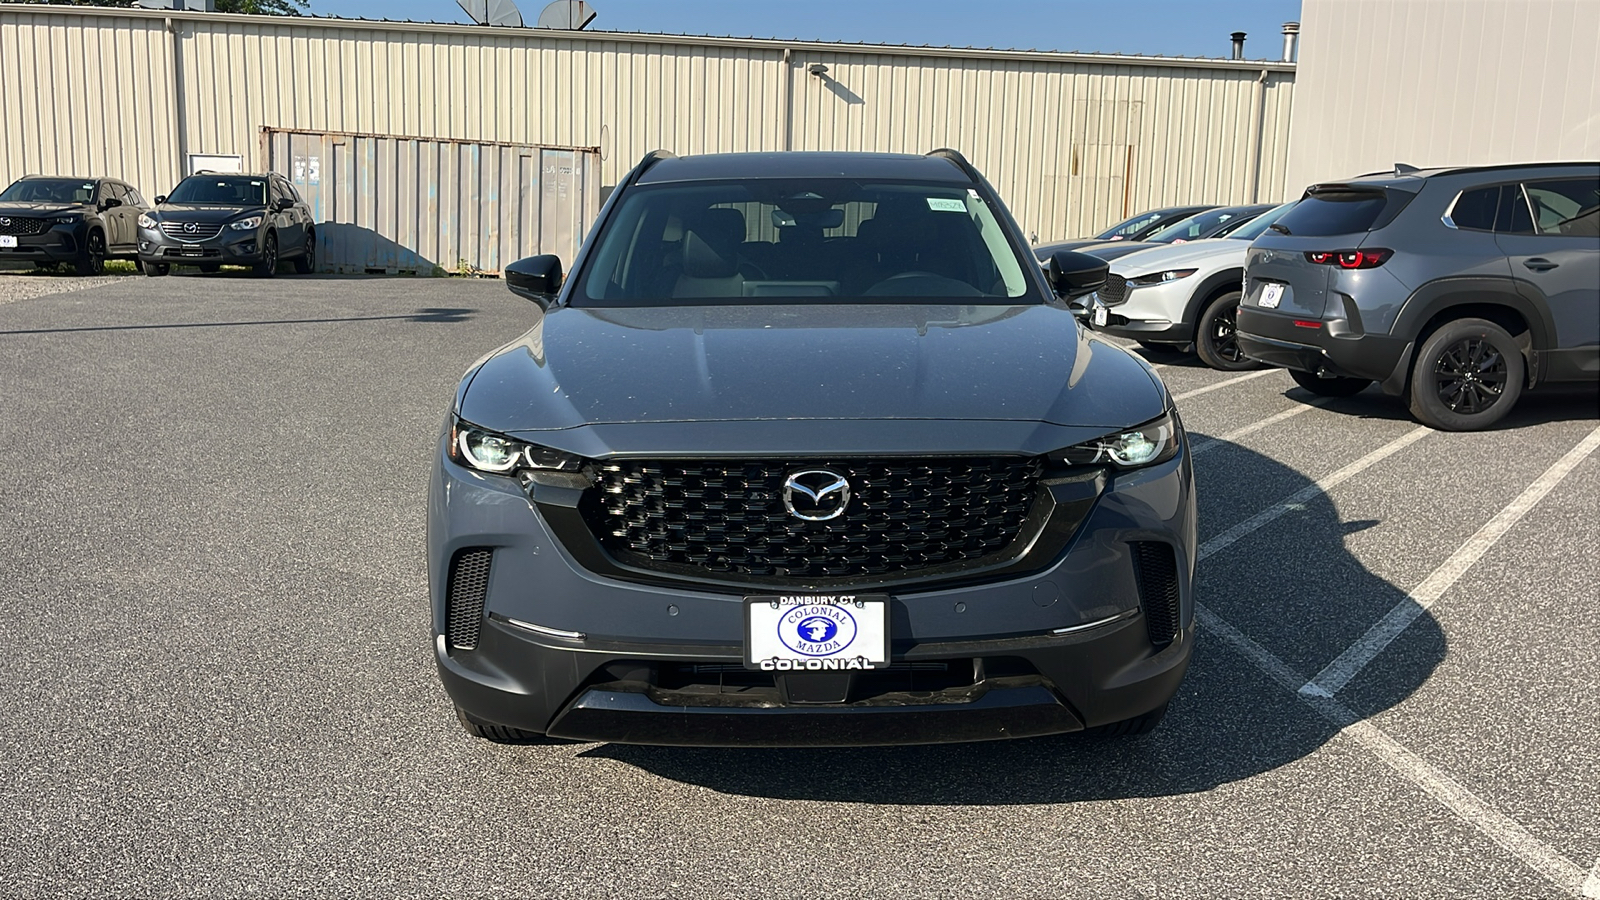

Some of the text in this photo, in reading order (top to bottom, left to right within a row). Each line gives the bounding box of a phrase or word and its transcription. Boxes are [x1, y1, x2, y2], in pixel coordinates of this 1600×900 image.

[839, 596, 856, 605] CT
[788, 606, 847, 625] COLONIAL
[795, 640, 841, 653] MAZDA
[760, 658, 875, 671] COLONIAL
